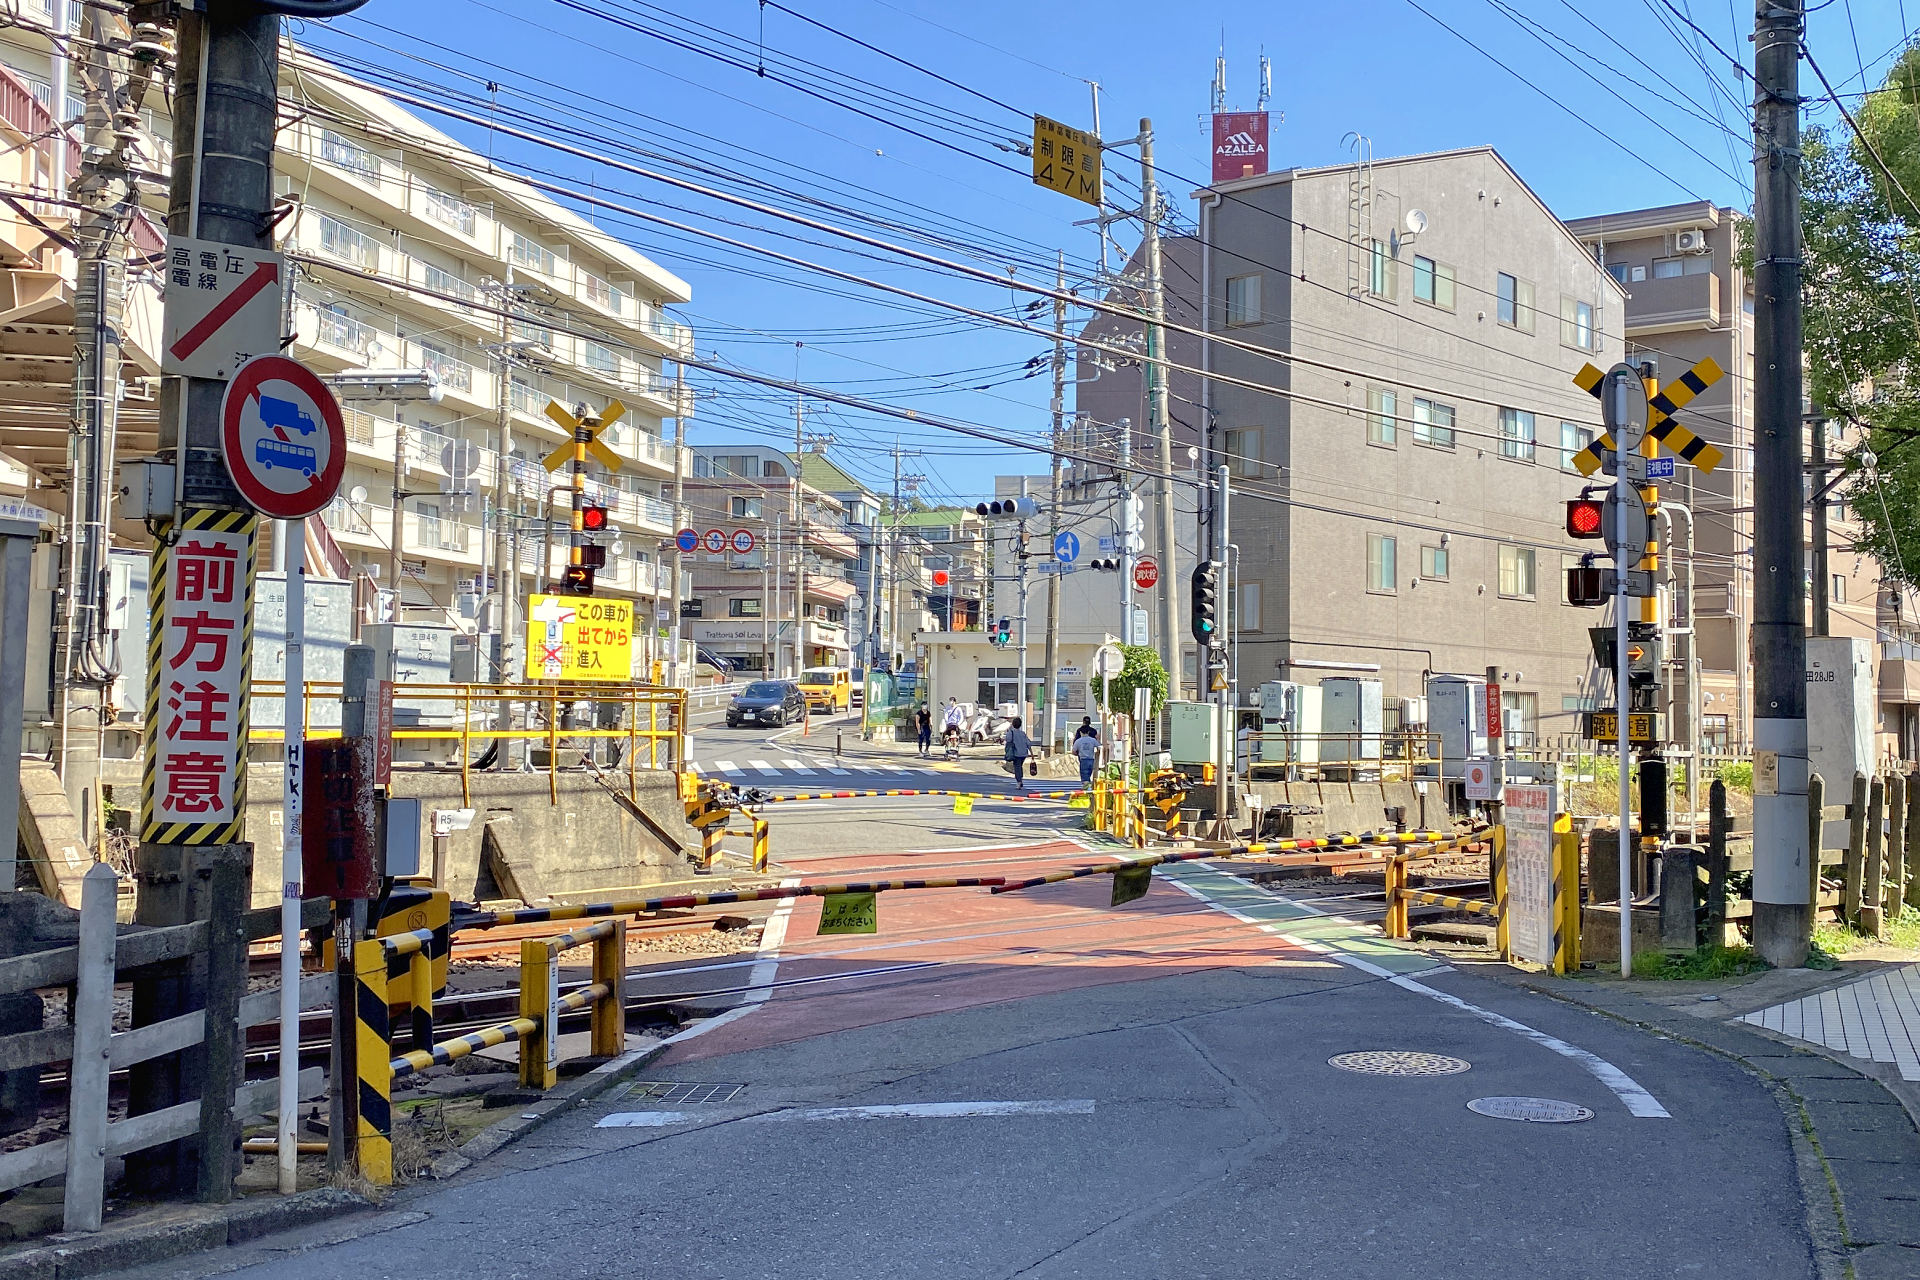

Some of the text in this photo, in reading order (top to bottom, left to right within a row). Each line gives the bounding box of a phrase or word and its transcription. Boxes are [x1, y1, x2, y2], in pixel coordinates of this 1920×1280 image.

[1041, 137, 1093, 174] 制限高
[1216, 143, 1265, 155] AZALEA
[1039, 162, 1095, 200] 4.7M
[171, 247, 245, 275] 高電圧
[171, 267, 218, 291] 電線
[735, 536, 750, 547] 40
[578, 603, 629, 623] この車が
[411, 633, 439, 642] 生田4号
[577, 626, 628, 646] 出てから
[705, 631, 772, 639] Trattoria Sol Levae
[577, 649, 602, 669] 進入
[161, 540, 238, 813] 前方注意
[1488, 687, 1499, 735] 非常ボタン
[379, 687, 391, 778] 非常ボタン
[440, 814, 452, 825] R5
[825, 903, 873, 915] しばらく
[822, 917, 873, 928] おまちください
